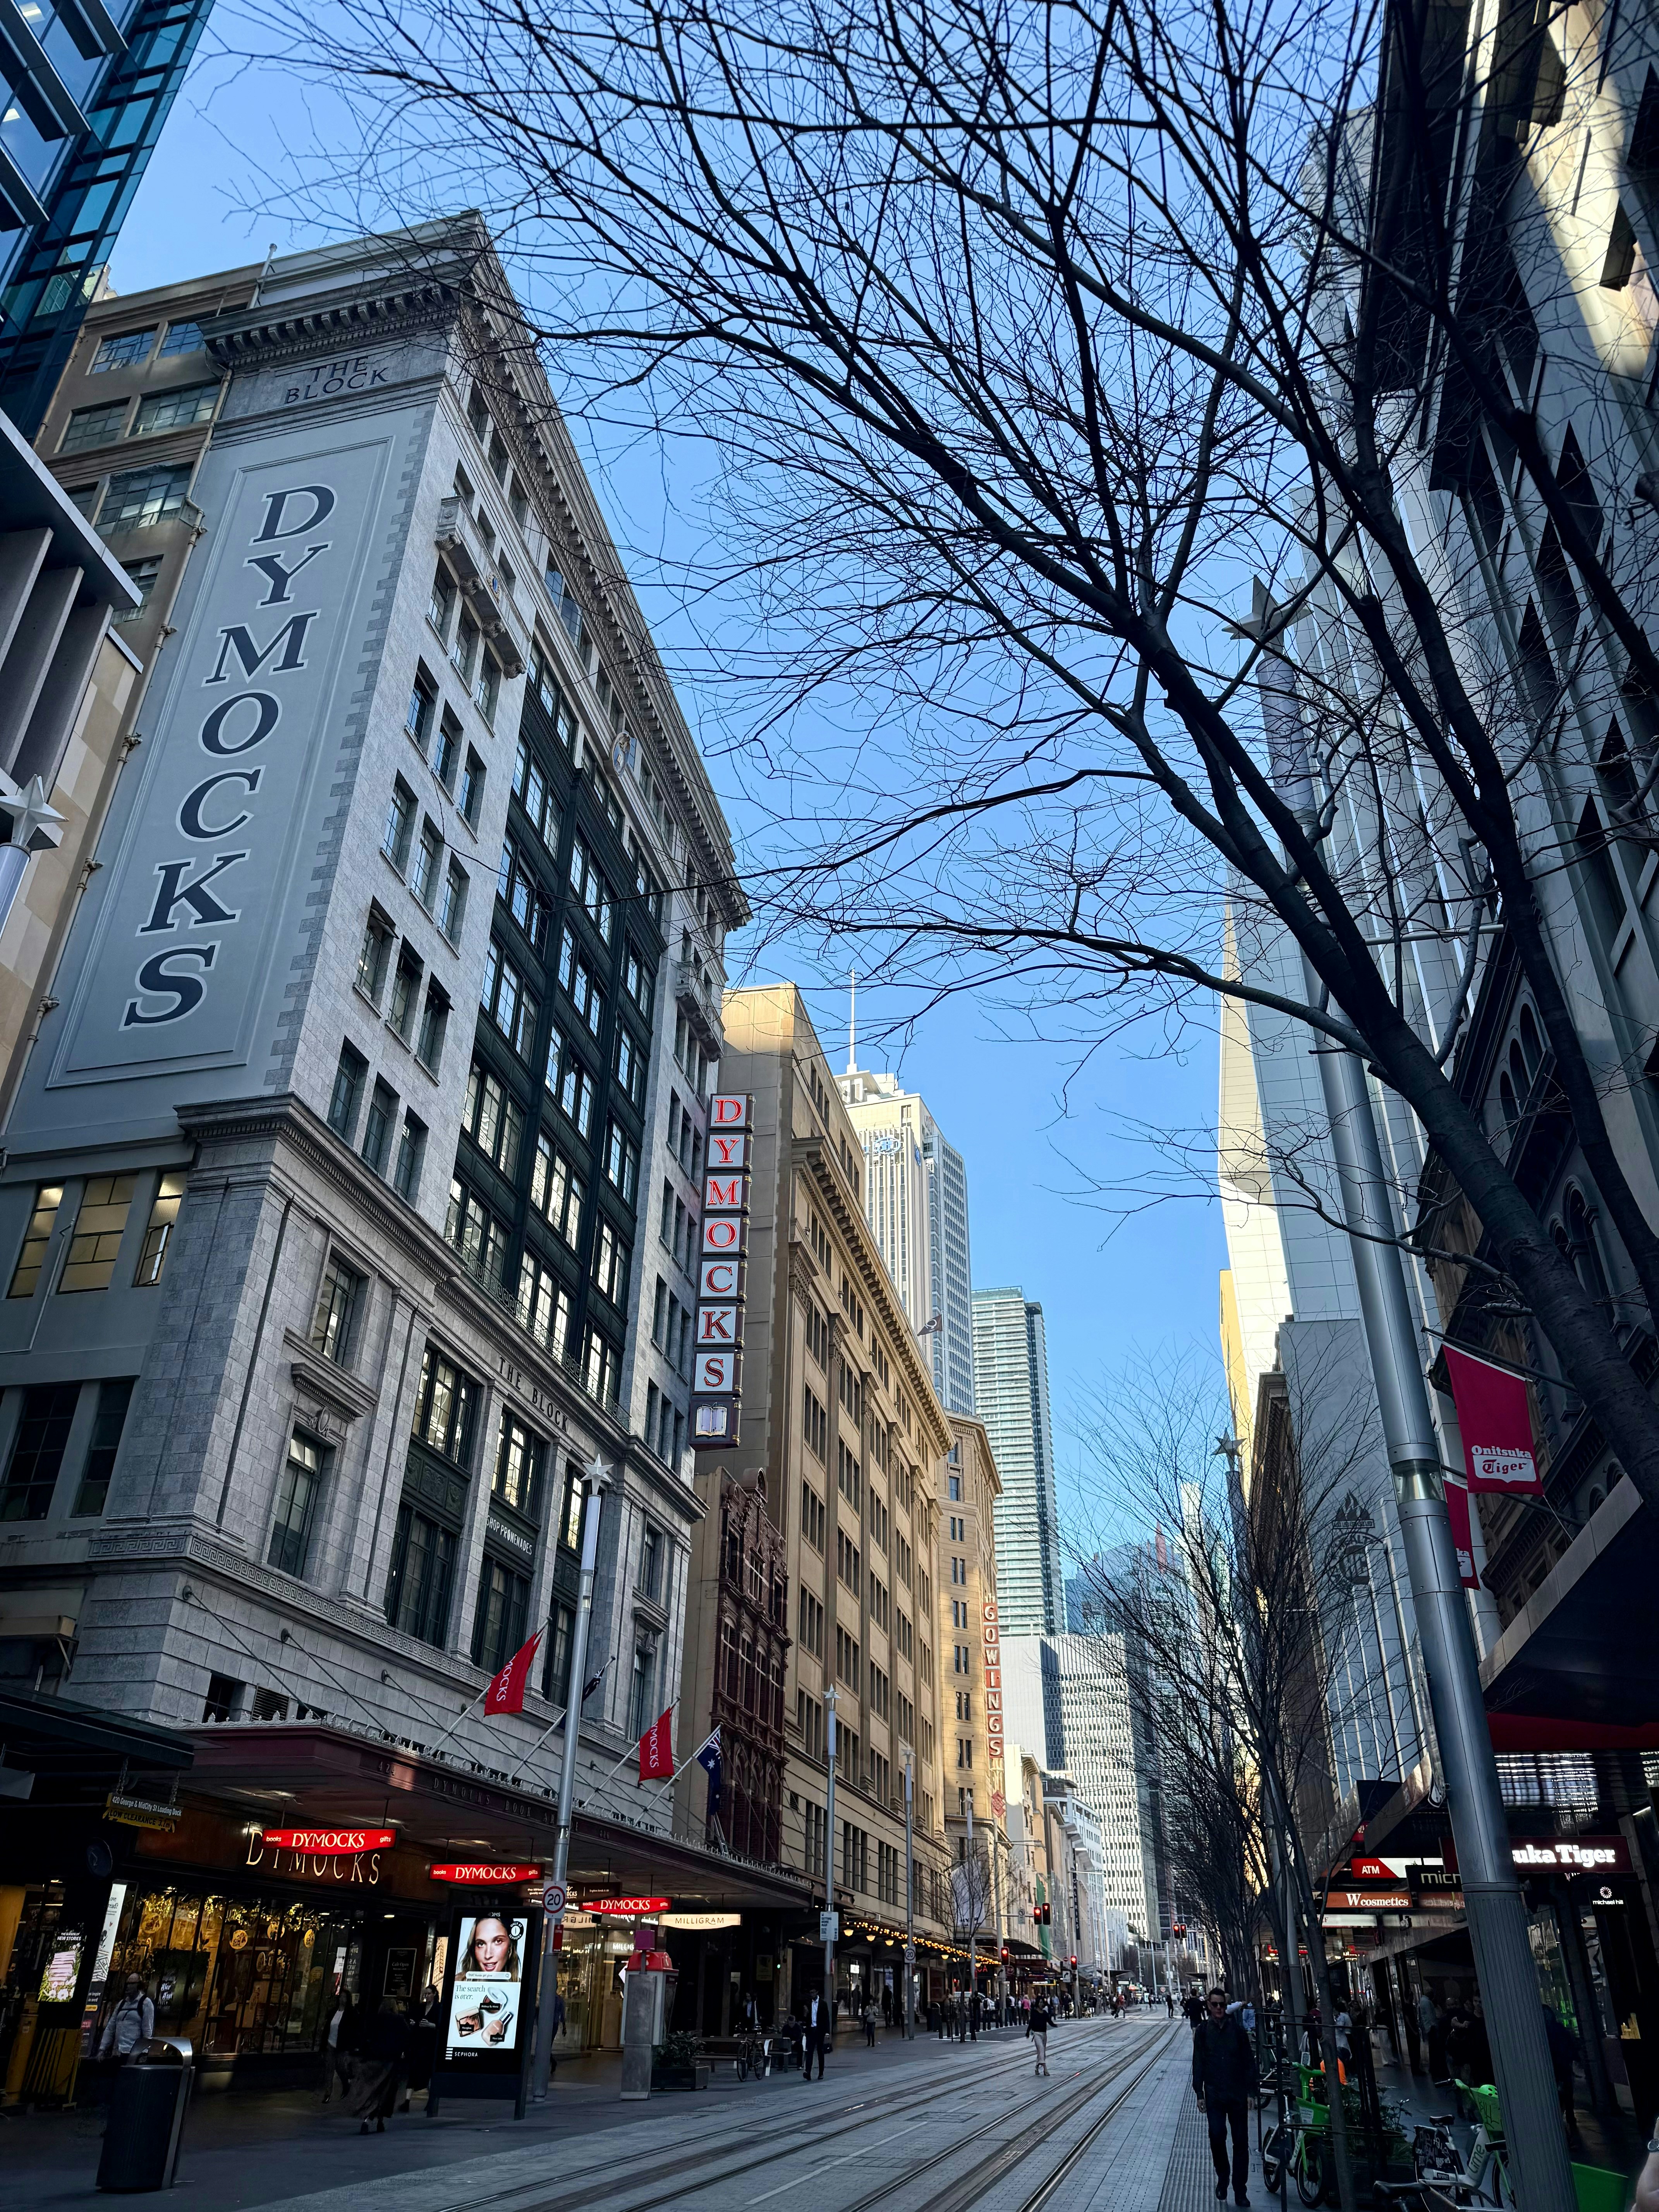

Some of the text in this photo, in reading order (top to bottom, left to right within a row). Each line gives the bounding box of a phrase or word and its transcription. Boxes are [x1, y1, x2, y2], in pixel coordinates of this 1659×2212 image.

[311, 356, 368, 382] THE
[283, 368, 388, 404] BLOCK
[118, 483, 337, 1031] DYMOCKS
[703, 1098, 742, 1386] DYMOCKS
[499, 1357, 568, 1431] THE BLOCK
[1472, 1445, 1532, 1459] Onitsuka
[1482, 1458, 1528, 1476] Tiger
[486, 1515, 532, 1555] SHOP PROMENADES
[496, 1654, 517, 1701] MOCKS
[984, 1606, 1001, 1756] GOWINGS
[649, 1721, 659, 1768] YMOCKS
[120, 1798, 134, 1807] George
[138, 1801, 152, 1811] MidCity
[505, 1800, 531, 1817] BOOK
[110, 1809, 122, 1818] LOW
[124, 1813, 156, 1825] CLEARANCE
[292, 1833, 365, 1848] DYMOCKS
[1555, 1845, 1615, 1867] Tiger
[455, 1867, 516, 1879] DYMOCKS
[1362, 1865, 1380, 1874] ATM
[547, 1894, 560, 1905] 20
[600, 1900, 650, 1910] DYMOCKS
